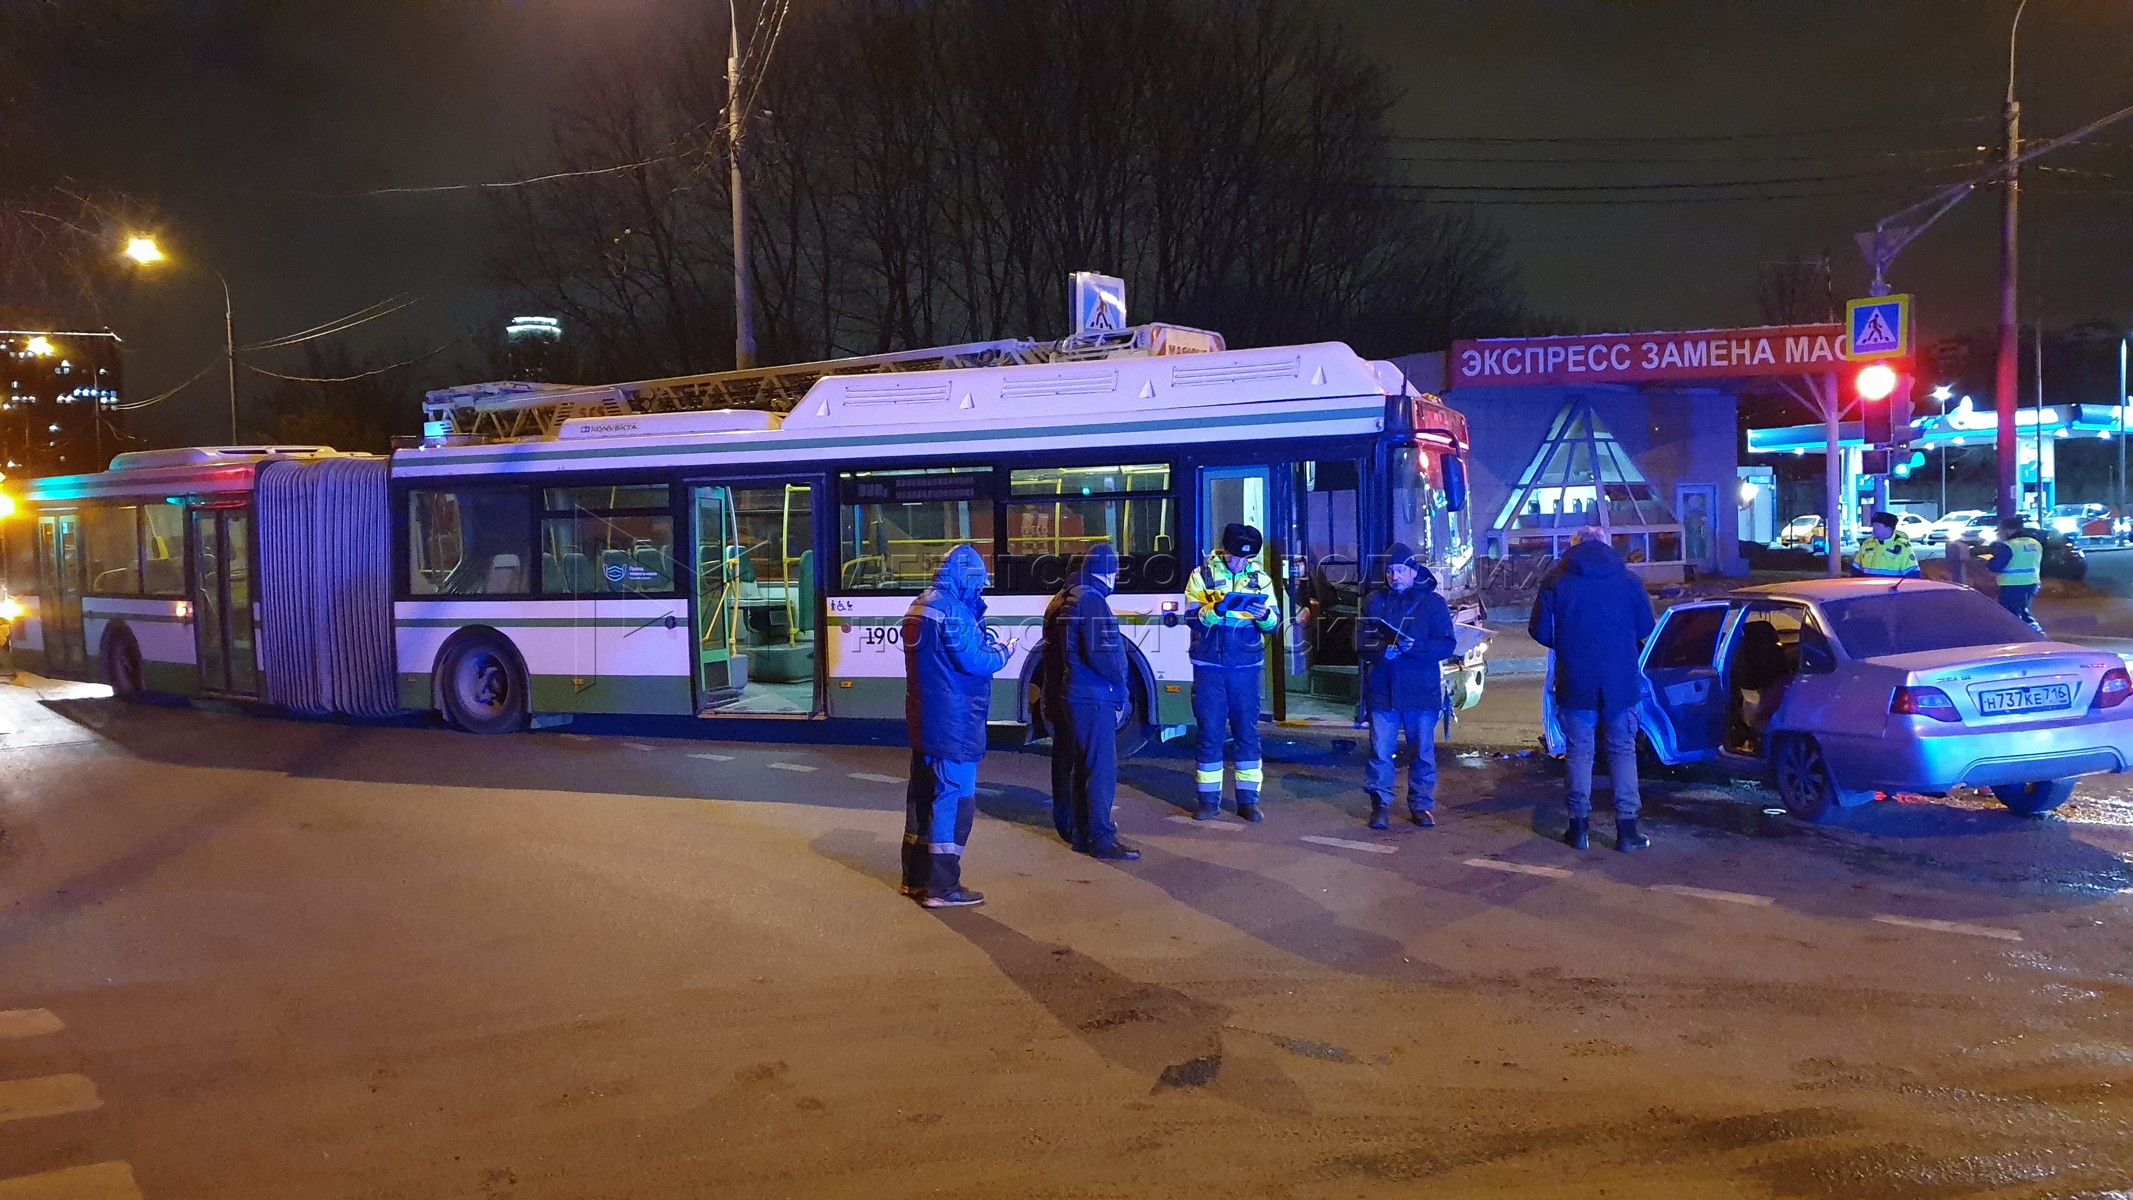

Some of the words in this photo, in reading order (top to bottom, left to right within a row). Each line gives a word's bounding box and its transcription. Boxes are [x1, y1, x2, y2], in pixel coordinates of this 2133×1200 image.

[1461, 342, 1631, 377] ЭКСПРЕСС
[1642, 337, 1776, 370] ЗАМЕНА
[1785, 334, 1846, 363] МАС
[866, 627, 903, 645] 190
[1987, 691, 2042, 710] Н737КЕ
[2043, 686, 2067, 700] 716
